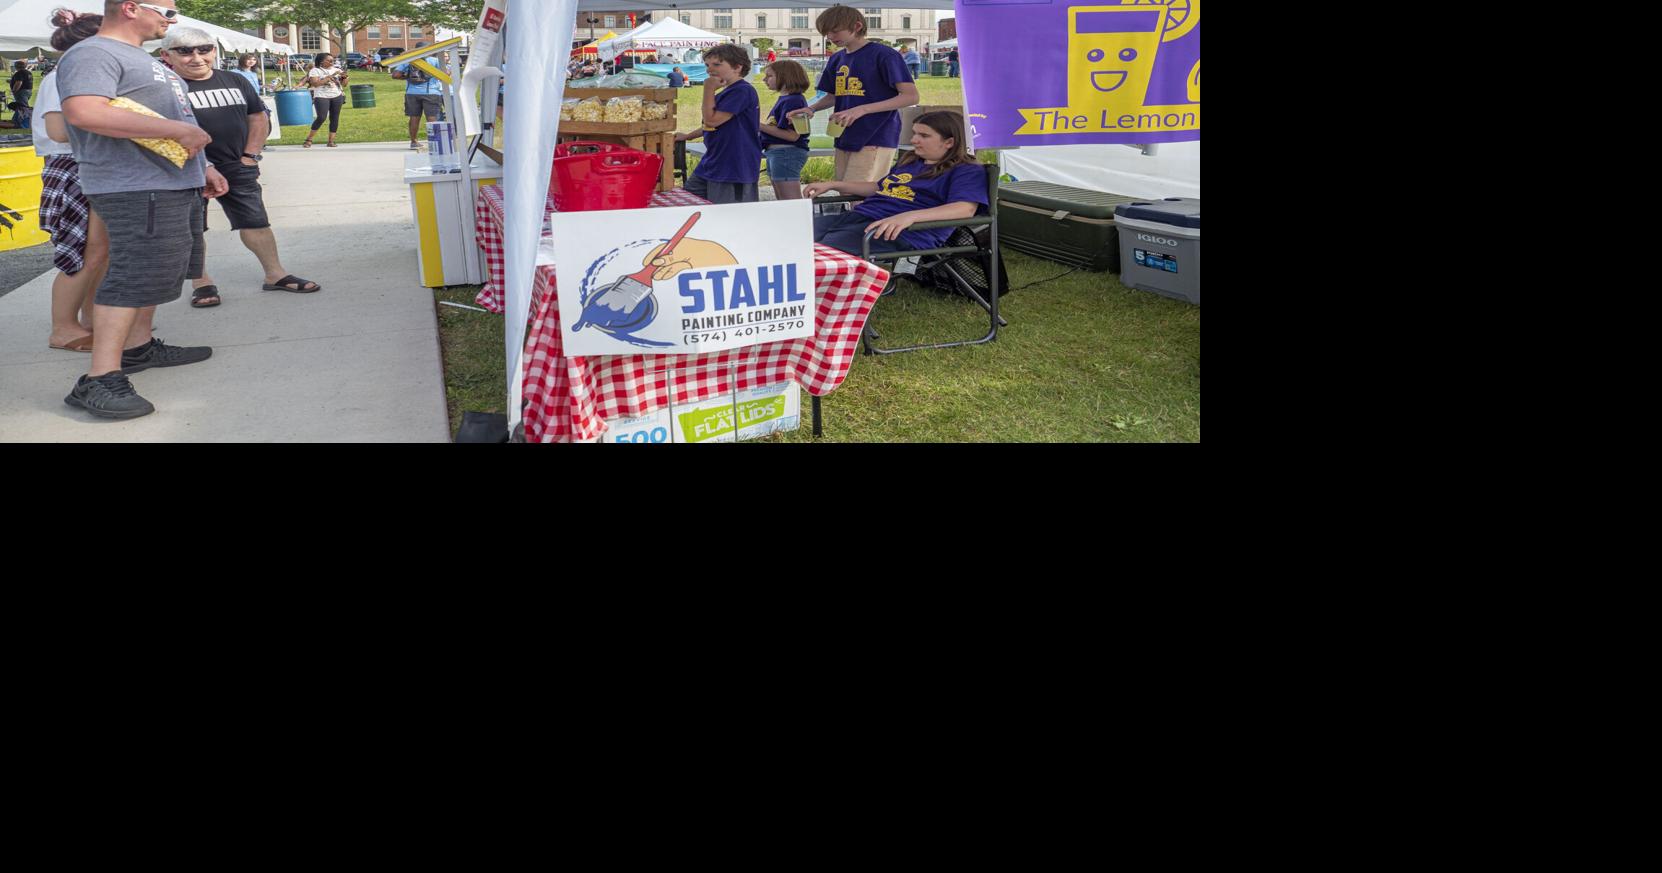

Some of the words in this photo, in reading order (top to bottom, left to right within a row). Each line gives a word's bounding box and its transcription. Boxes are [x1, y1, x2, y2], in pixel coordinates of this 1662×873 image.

[187, 88, 247, 109] UMA
[1034, 111, 1088, 131] The
[1100, 109, 1195, 130] Lemon
[1137, 233, 1178, 247] IGLOO
[1135, 250, 1146, 261] 5
[678, 263, 807, 314] STAHL
[682, 313, 744, 331] PAINTING
[748, 304, 806, 323] COMPANY
[683, 331, 727, 346] (574)
[734, 320, 805, 338] 401-2570
[739, 403, 777, 424] LIDS
